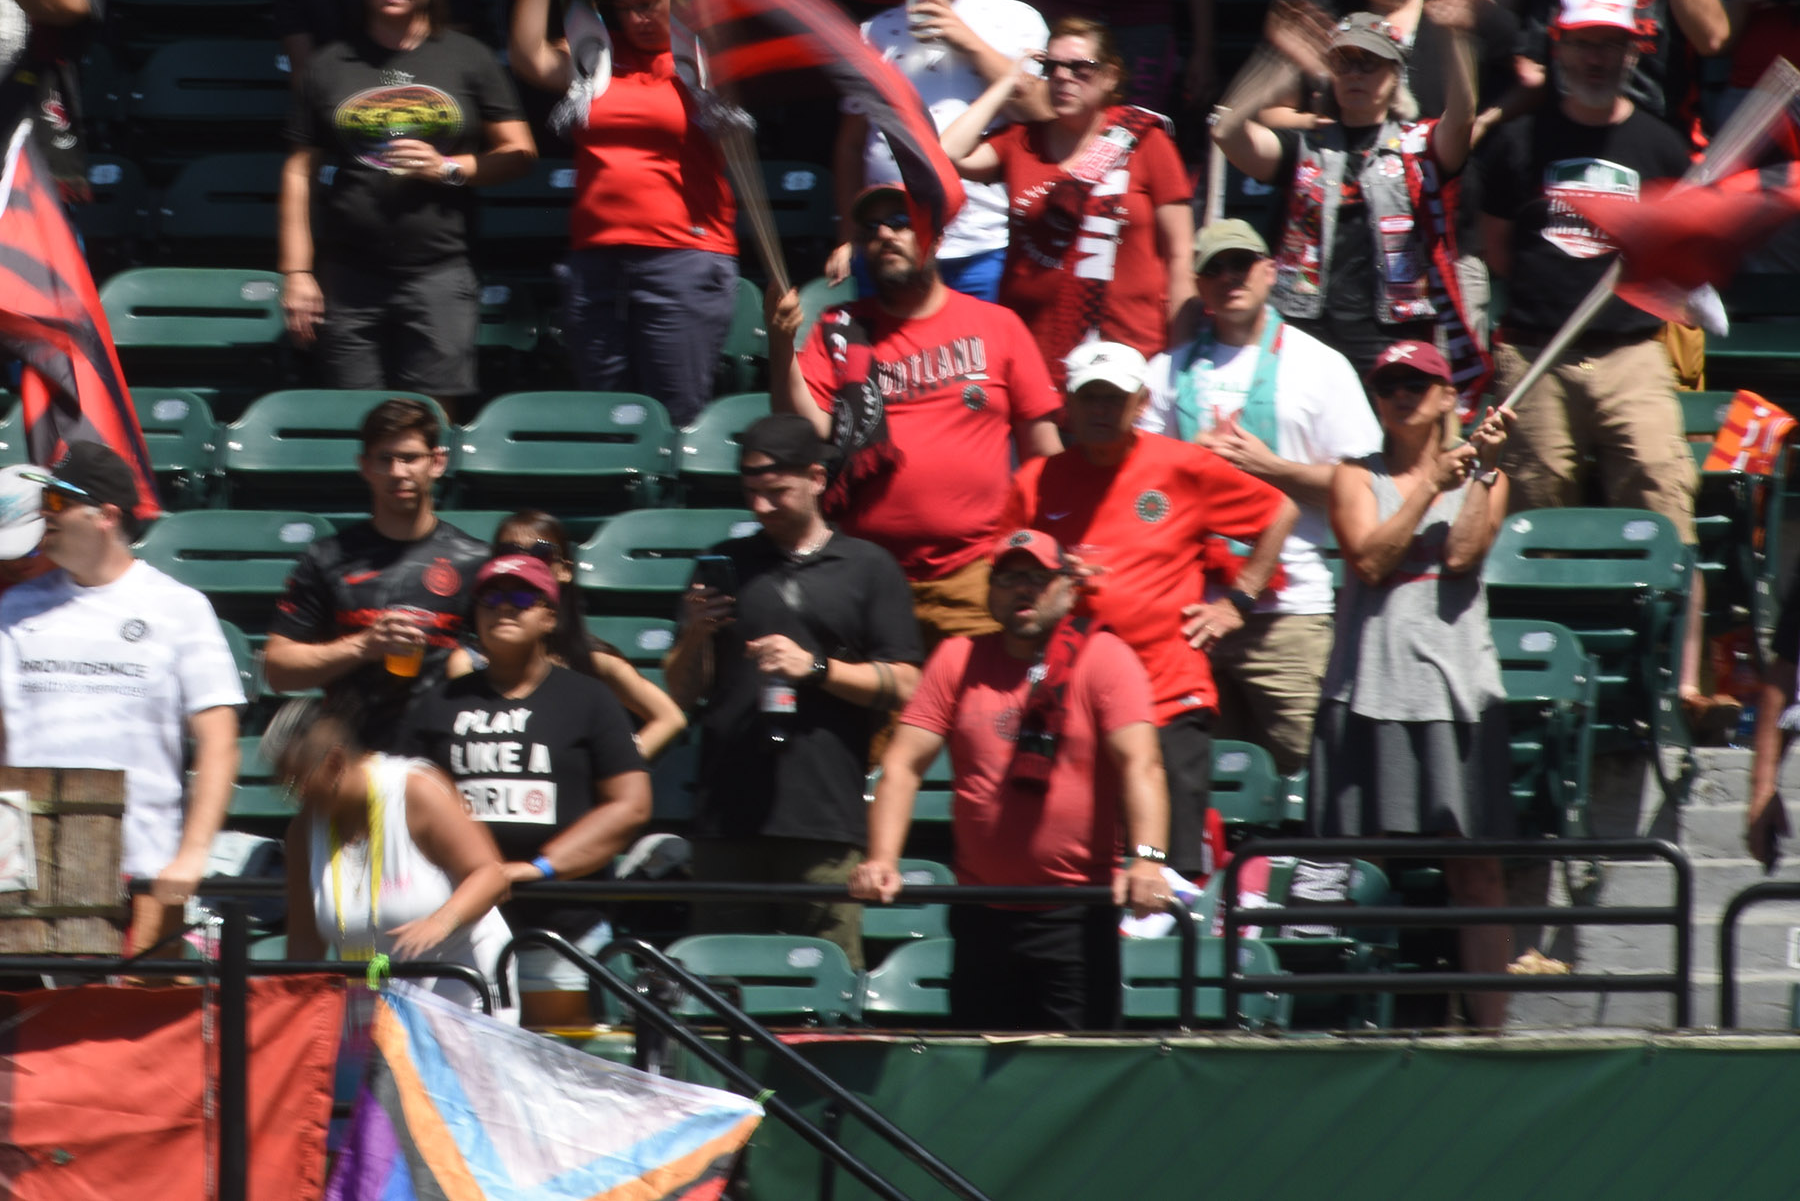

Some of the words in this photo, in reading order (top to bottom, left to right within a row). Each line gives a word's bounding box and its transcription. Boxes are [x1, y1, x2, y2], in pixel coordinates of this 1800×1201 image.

[452, 707, 533, 736] PLAY
[450, 741, 524, 775] LIKE
[527, 743, 553, 774] A
